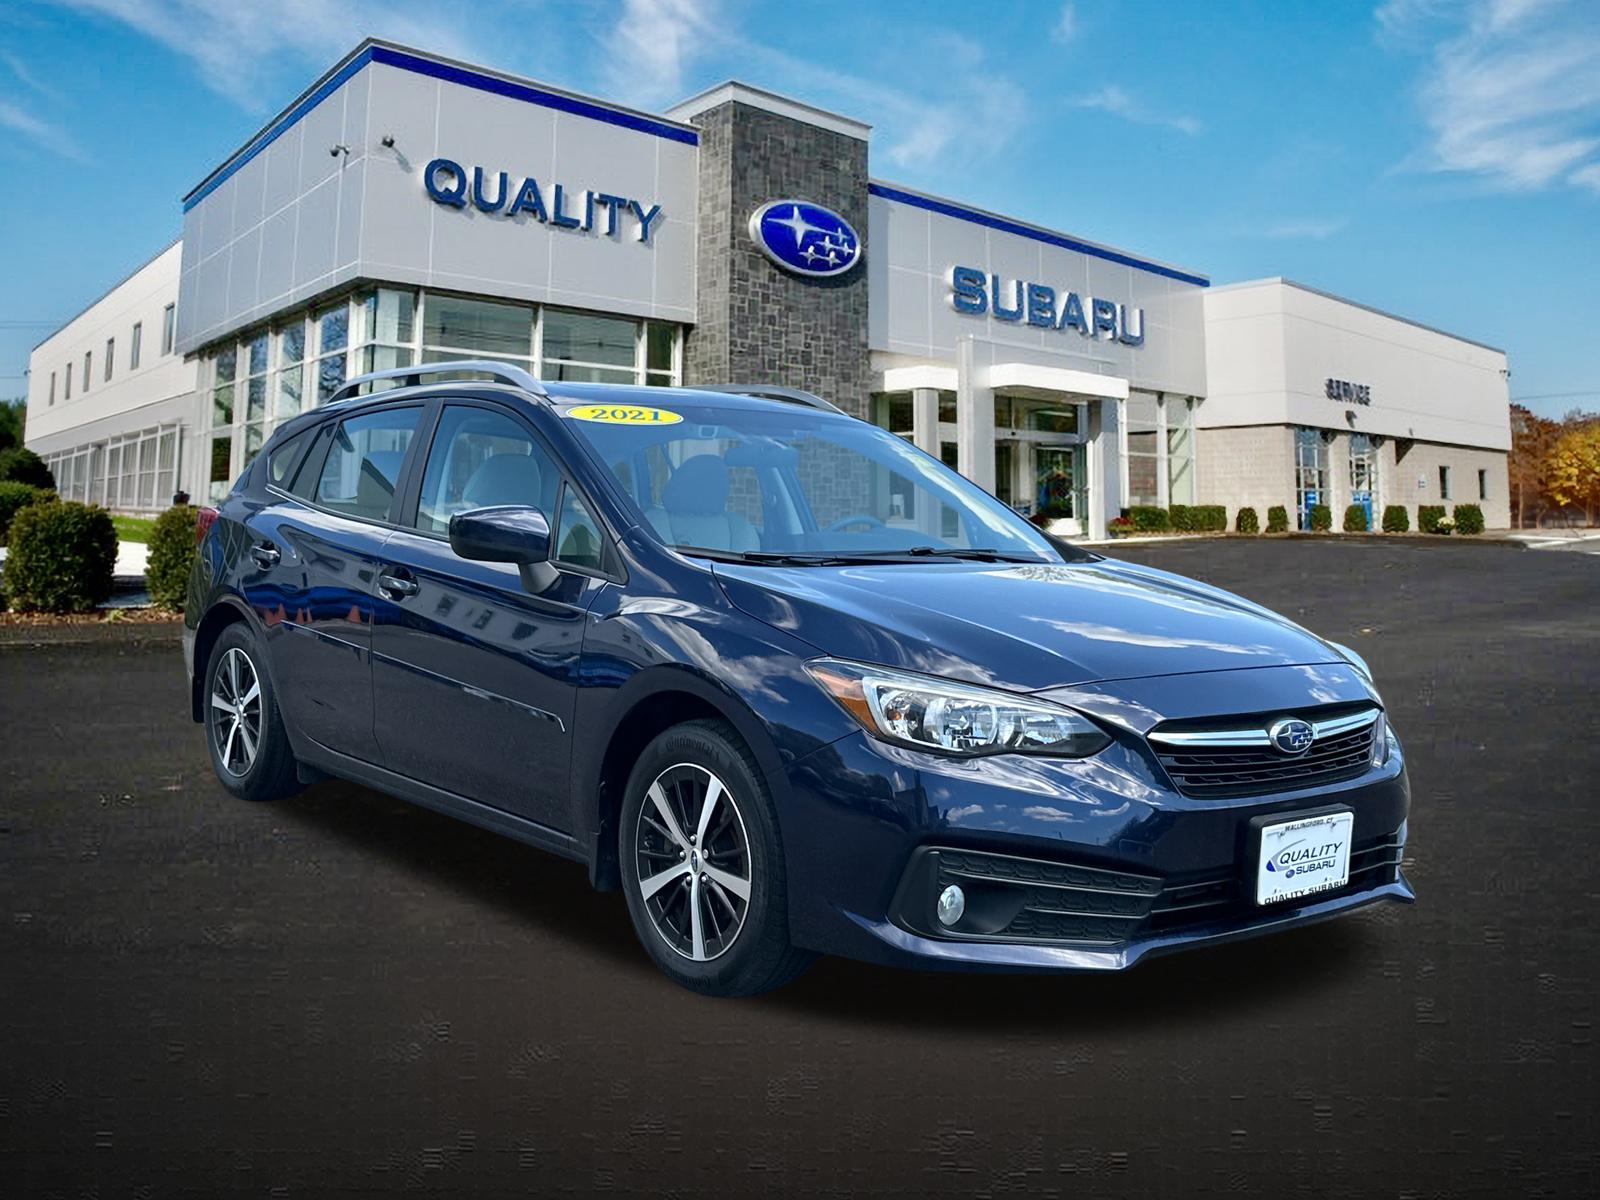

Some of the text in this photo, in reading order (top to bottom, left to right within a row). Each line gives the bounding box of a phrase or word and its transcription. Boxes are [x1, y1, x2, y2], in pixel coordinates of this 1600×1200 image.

[424, 158, 662, 243] QUALITY
[946, 265, 1145, 347] SUBARU
[1325, 378, 1371, 406] SERVICE
[590, 408, 662, 421] 2021
[1279, 842, 1343, 865] QUALITY
[1296, 859, 1336, 875] SUBARU
[1265, 879, 1346, 905] QUALITY SUBARU
